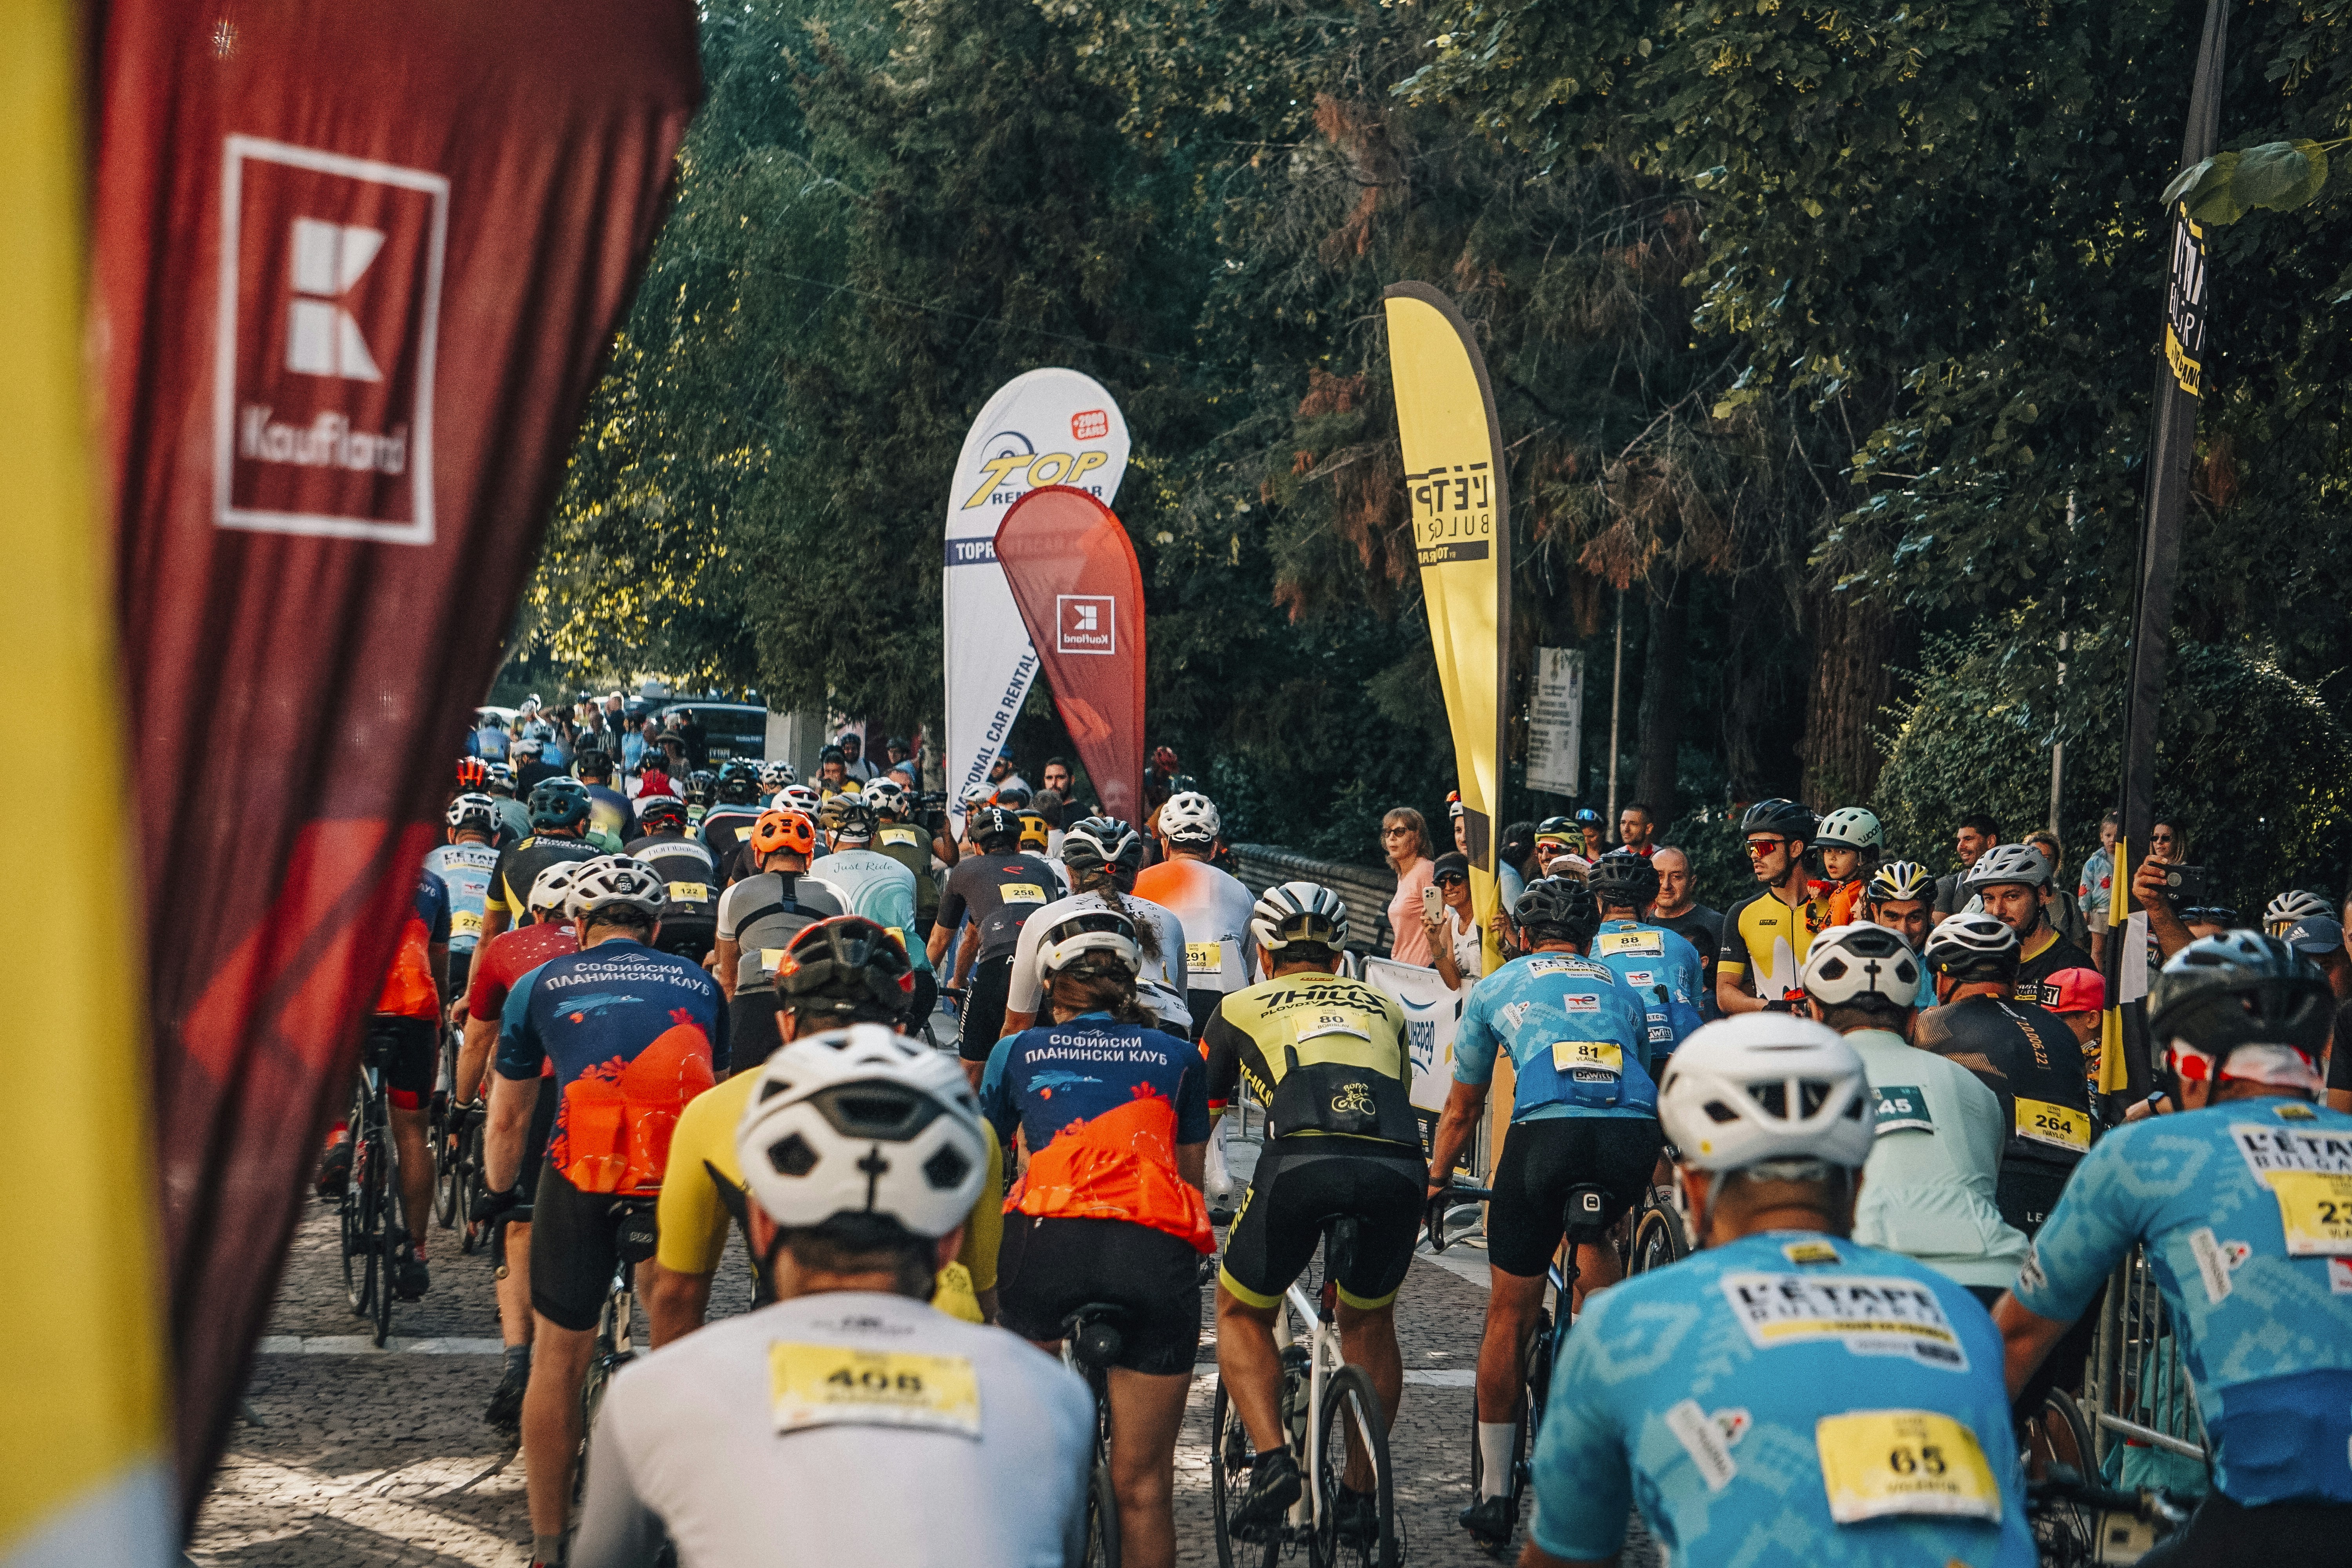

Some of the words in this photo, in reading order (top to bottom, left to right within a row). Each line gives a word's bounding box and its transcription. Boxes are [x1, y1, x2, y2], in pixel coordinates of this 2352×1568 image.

[961, 451, 1108, 510] TOP
[992, 492, 1027, 505] REN
[956, 542, 996, 560] TOPR
[987, 710, 1010, 743] CAR
[1002, 653, 1036, 711] RENTAL
[834, 862, 859, 873] Just
[865, 862, 893, 871] Ride
[1185, 952, 1207, 961] 291
[574, 962, 684, 975] СОФИЙСКИ
[546, 972, 665, 991] ПЛАНИНСКИ
[670, 976, 710, 996] КЛУБ
[959, 986, 973, 1043] SAMSIC
[1260, 1001, 1320, 1019] PLOVDIV
[1049, 1034, 1142, 1048] СОФИЙСКИ
[1025, 1049, 1124, 1064] ПЛАНИНСКИ
[1129, 1050, 1167, 1065] КЛУБ
[1578, 1045, 1598, 1058] 81
[1875, 1098, 1913, 1116] 45
[2034, 1114, 2073, 1135] 264
[2043, 1130, 2065, 1140] IVAYLO
[1889, 1445, 1947, 1475] 65
